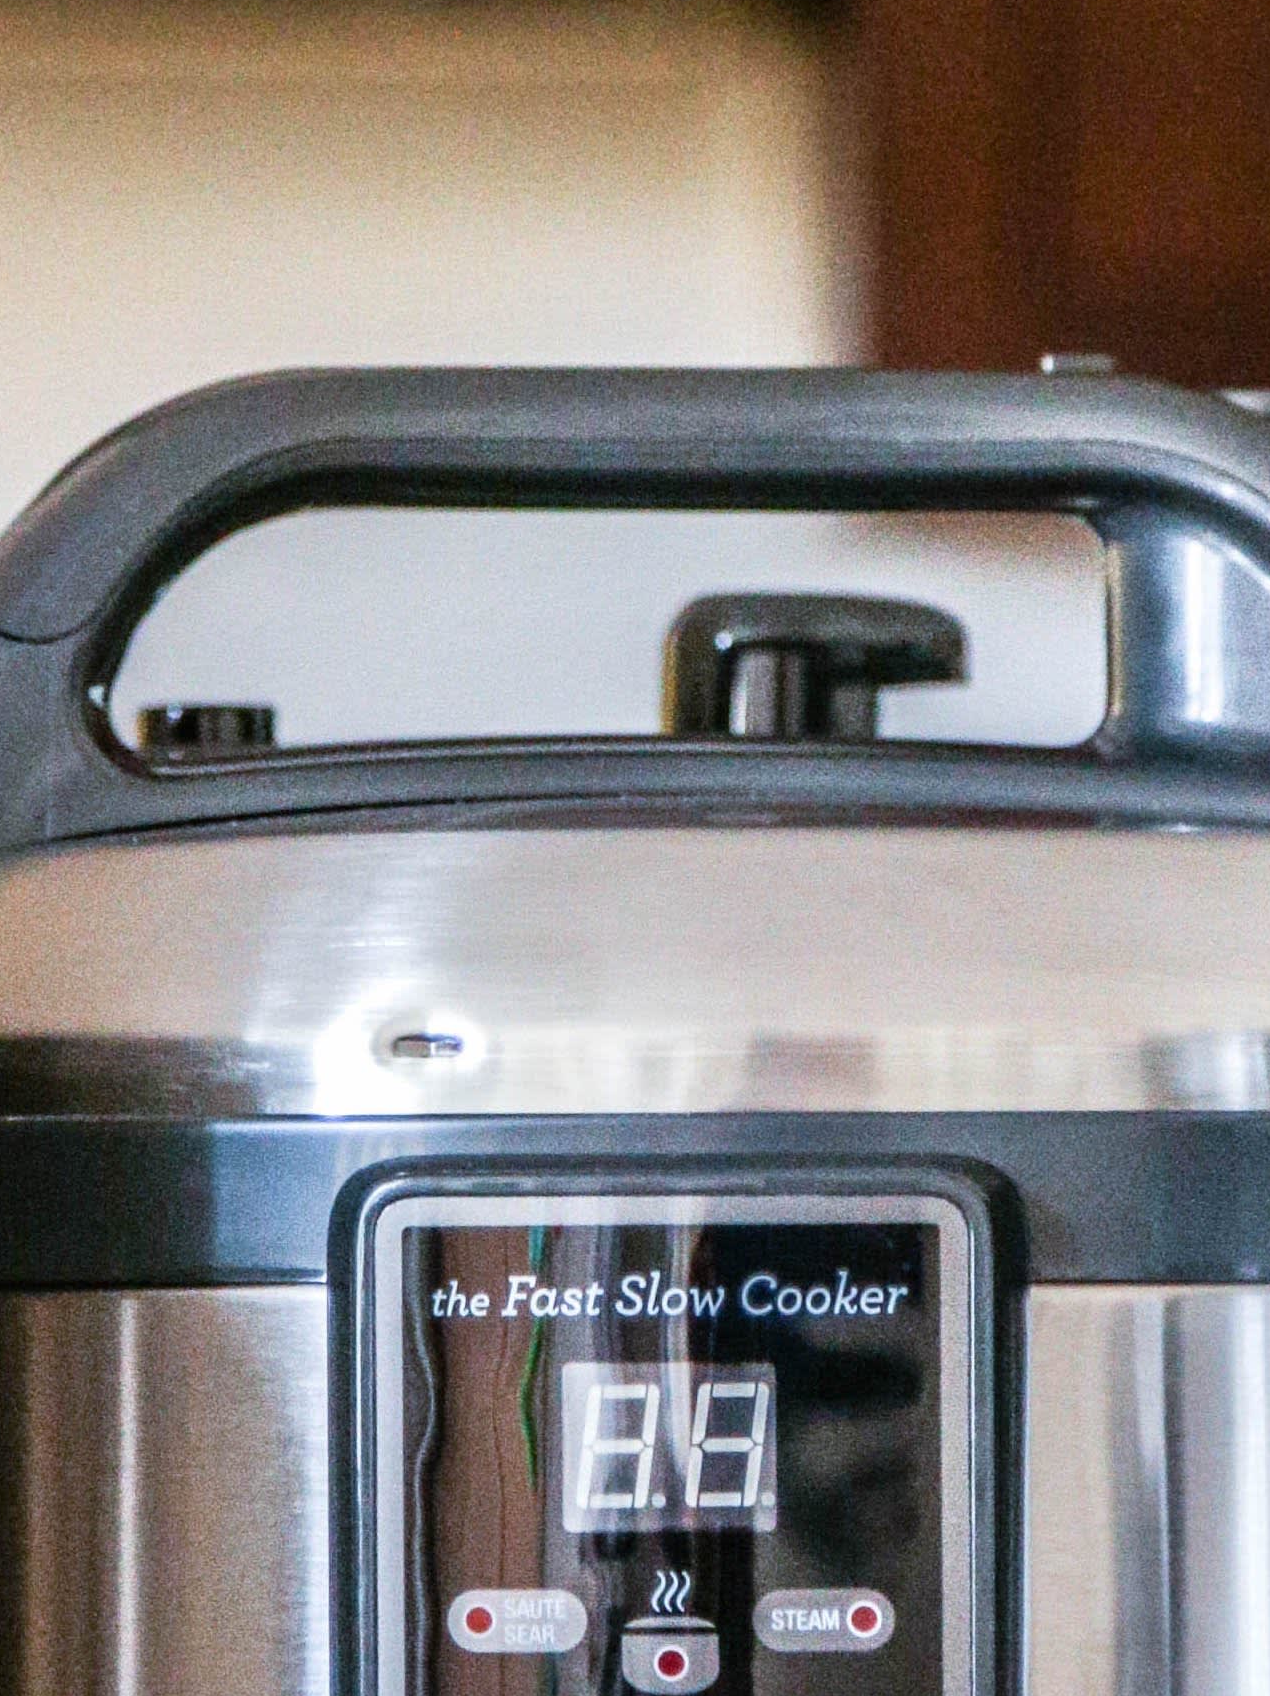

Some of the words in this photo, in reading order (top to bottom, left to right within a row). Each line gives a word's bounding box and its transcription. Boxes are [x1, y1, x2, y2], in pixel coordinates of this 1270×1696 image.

[432, 1279, 489, 1317] the
[501, 1274, 603, 1317] Fast
[615, 1271, 724, 1316] Slow
[741, 1271, 908, 1316] Cooker
[771, 1608, 840, 1631] STEAM
[504, 1624, 556, 1645] SEAR
